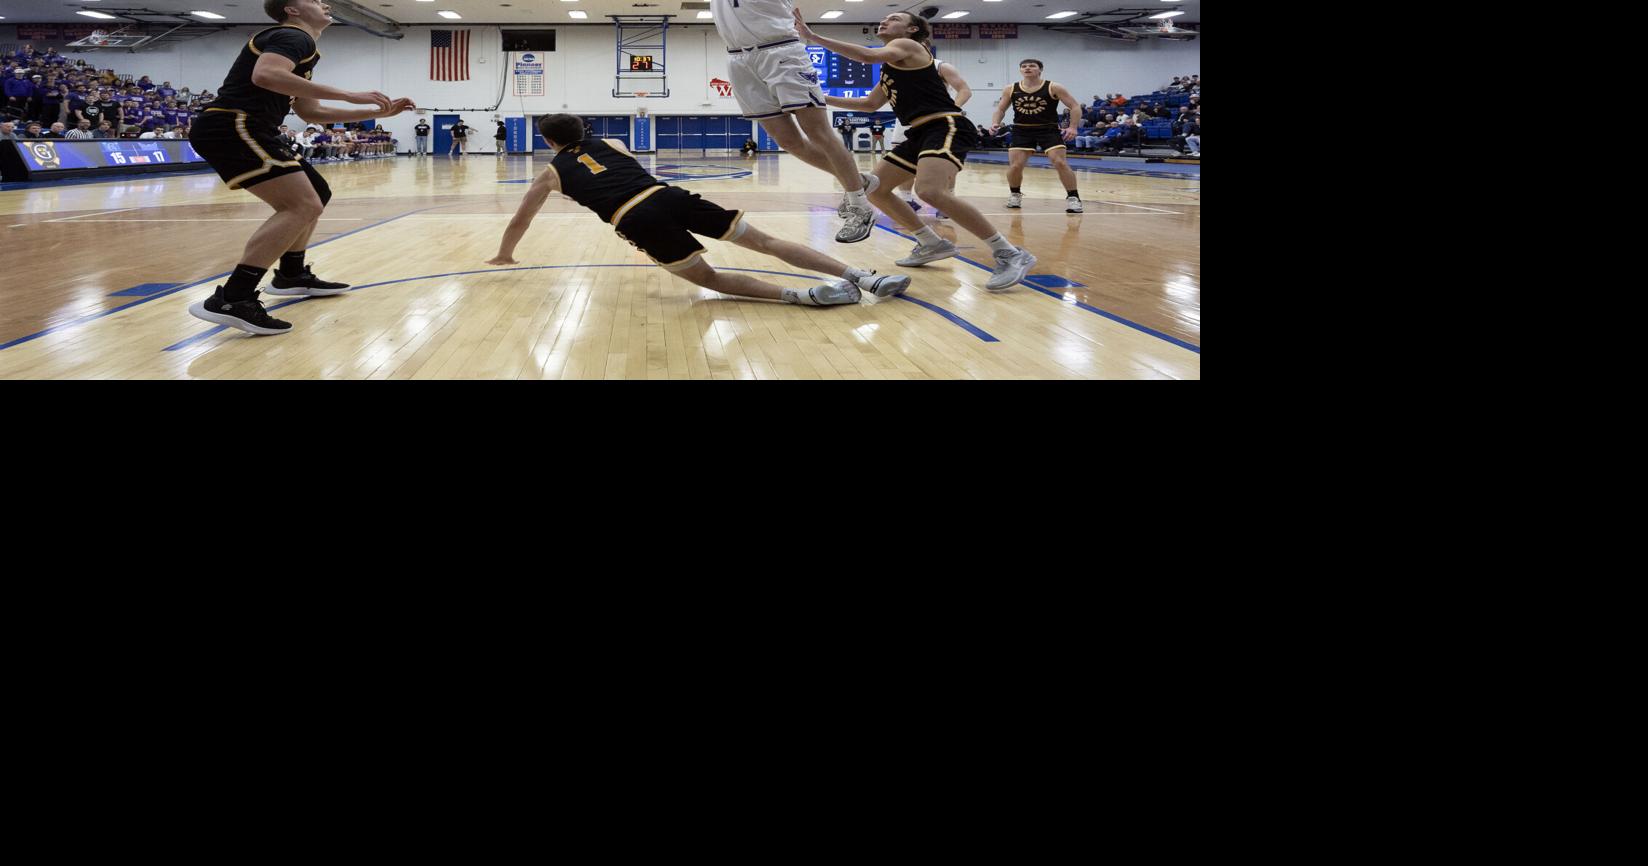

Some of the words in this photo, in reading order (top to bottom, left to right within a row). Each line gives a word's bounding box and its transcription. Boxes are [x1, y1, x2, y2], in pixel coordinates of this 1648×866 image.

[110, 152, 127, 164] 15
[153, 151, 165, 162] 17
[577, 153, 608, 175] 1
